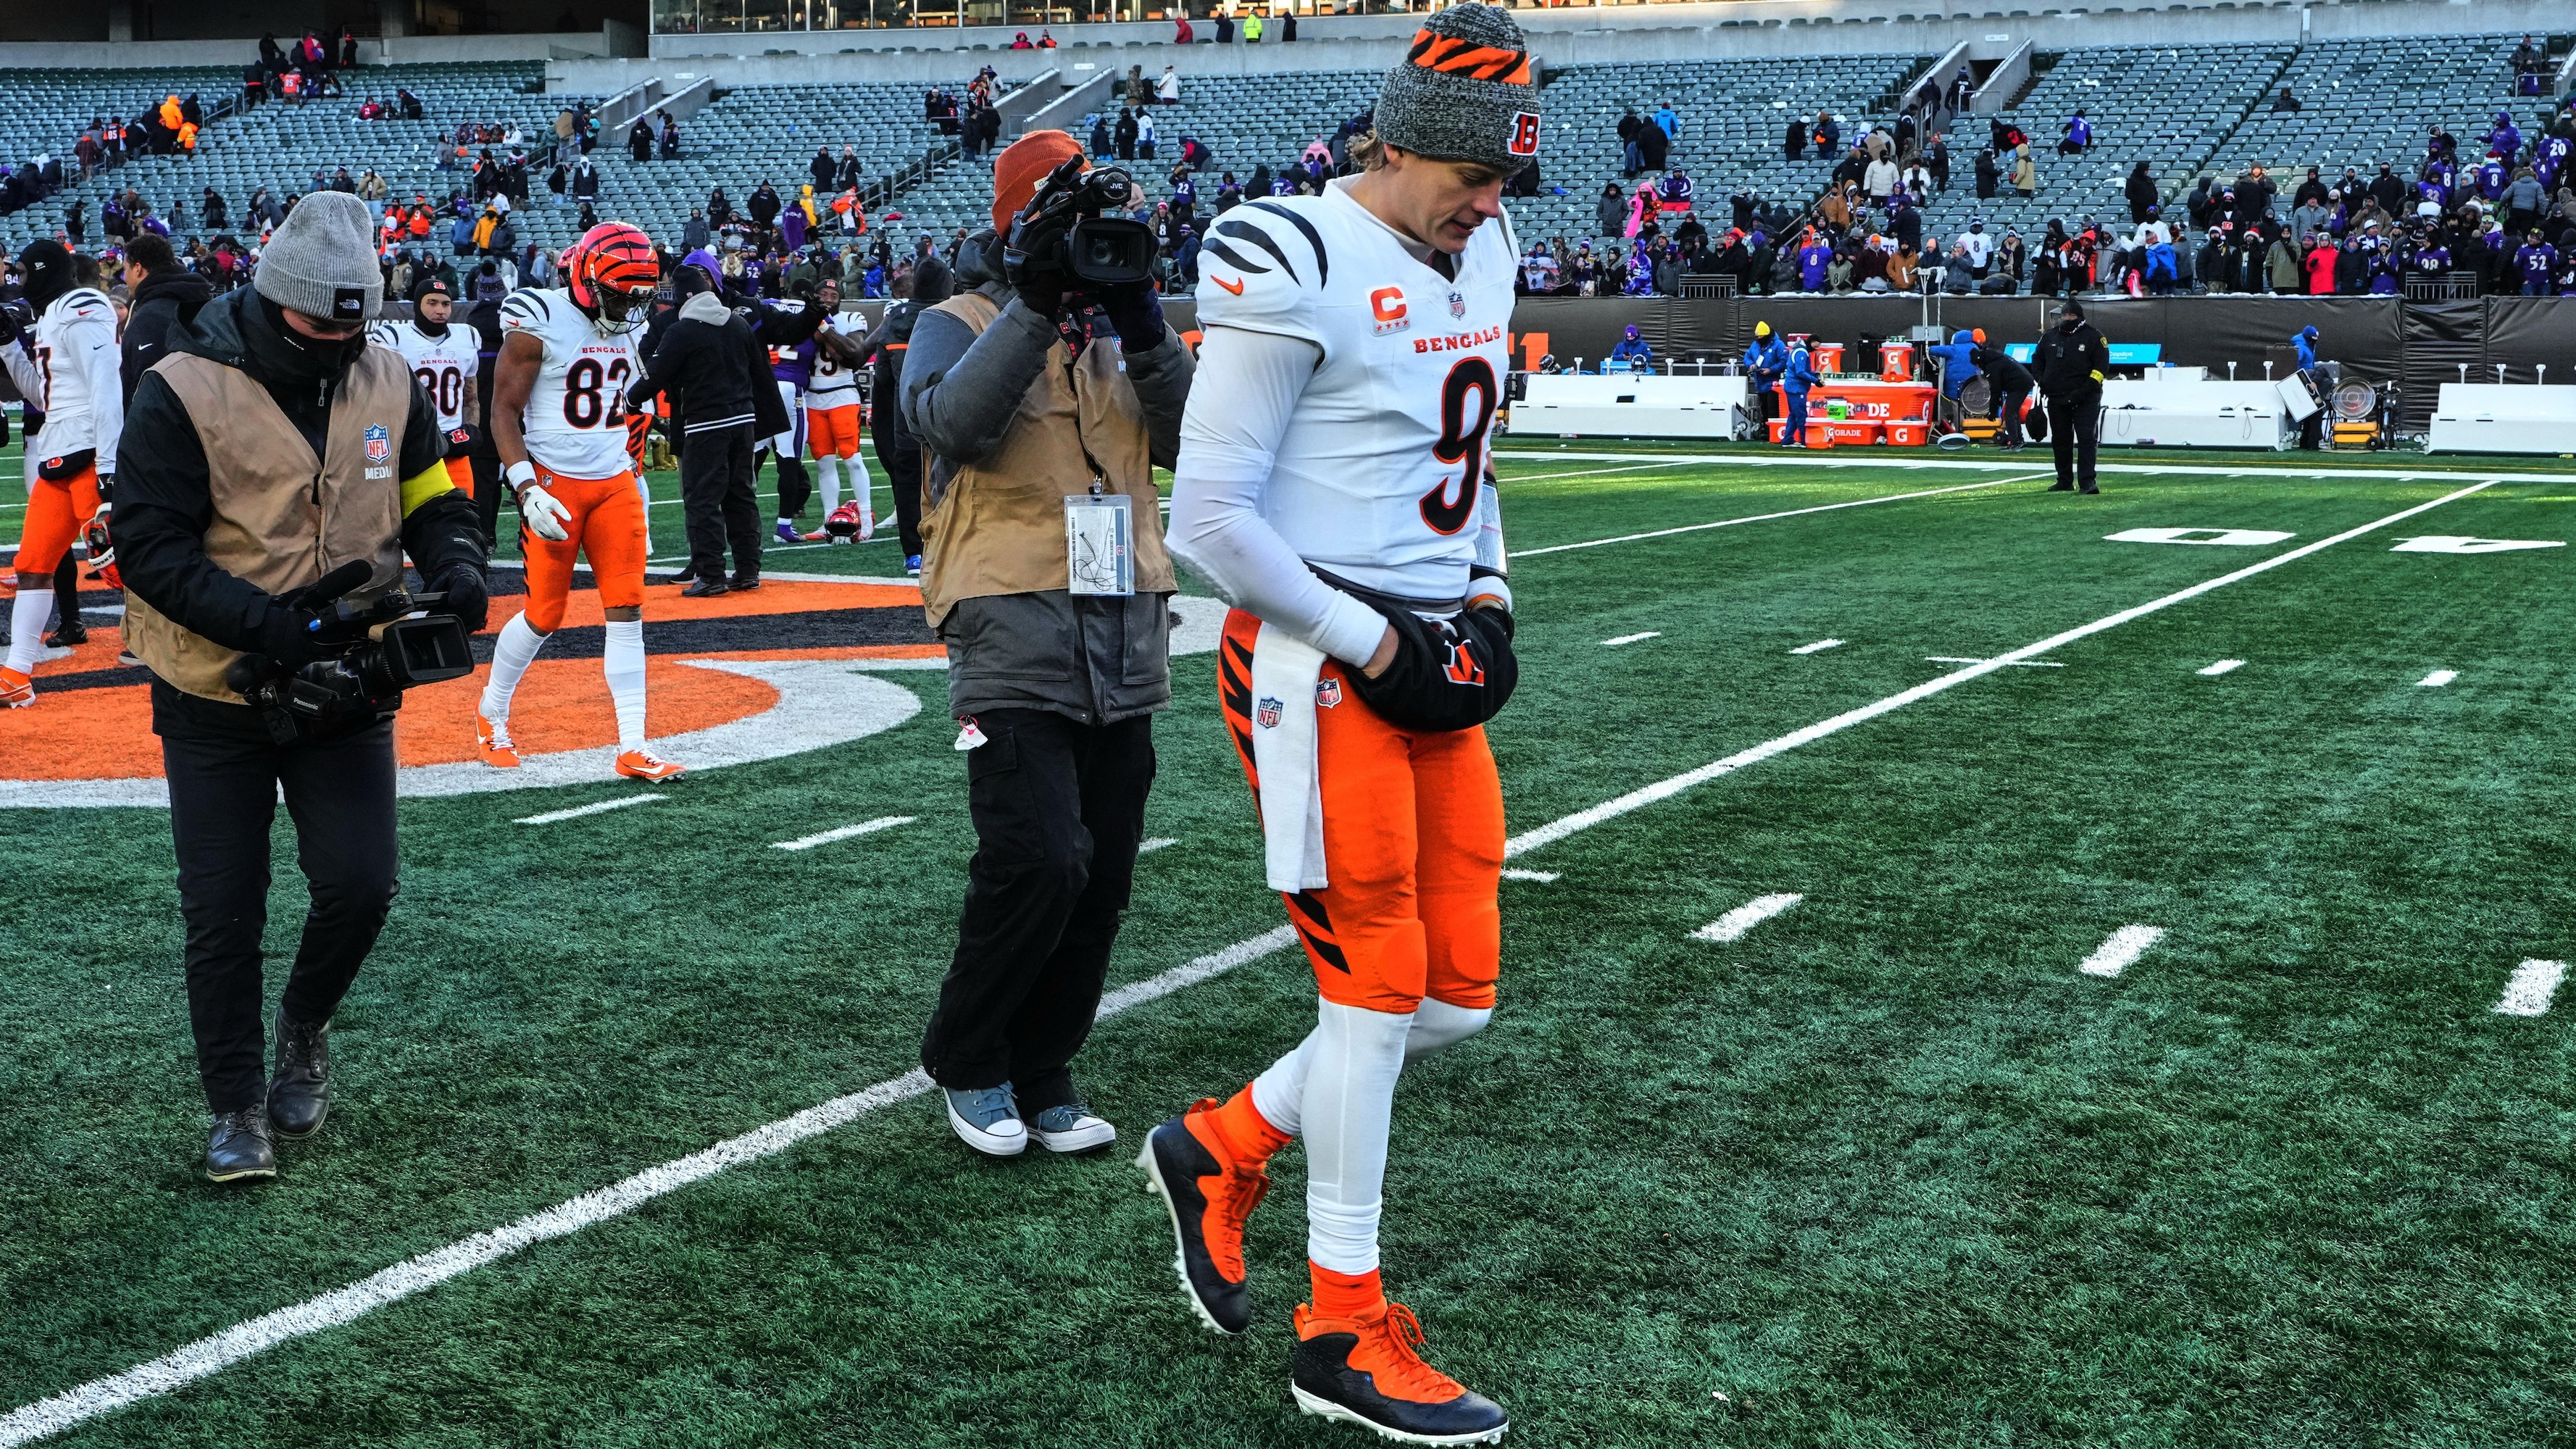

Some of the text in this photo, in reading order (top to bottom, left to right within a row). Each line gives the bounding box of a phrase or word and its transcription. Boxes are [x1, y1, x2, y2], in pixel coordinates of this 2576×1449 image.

[2079, 122, 2085, 131] 8
[1506, 111, 1541, 156] B
[2550, 143, 2567, 156] 20
[2540, 164, 2546, 174] 4
[2443, 172, 2451, 187] 8
[2491, 173, 2498, 186] 8
[1177, 183, 1189, 195] 22
[414, 209, 420, 221] 9
[1159, 224, 1167, 236] 8
[1883, 245, 1895, 256] 75
[1973, 241, 1980, 253] 8
[1810, 254, 1818, 267] 8
[2529, 255, 2547, 270] 52
[5, 273, 19, 285] 94
[746, 267, 759, 279] 52
[1833, 272, 1841, 286] 8
[770, 302, 805, 314] IMPSON
[1370, 286, 1407, 322] C
[1451, 301, 1464, 313] NFL
[1413, 325, 1501, 354] BENGALS
[1818, 352, 1830, 365] G
[1887, 351, 1898, 364] G
[563, 357, 632, 430] 82
[449, 428, 470, 444] B
[1895, 428, 1908, 443] G
[367, 440, 387, 458] NFL
[1419, 356, 1498, 535] 9
[364, 466, 392, 480] MEDI
[1320, 690, 1338, 703] NFL
[293, 697, 319, 710] Panasonic
[1259, 710, 1278, 725] NFL
